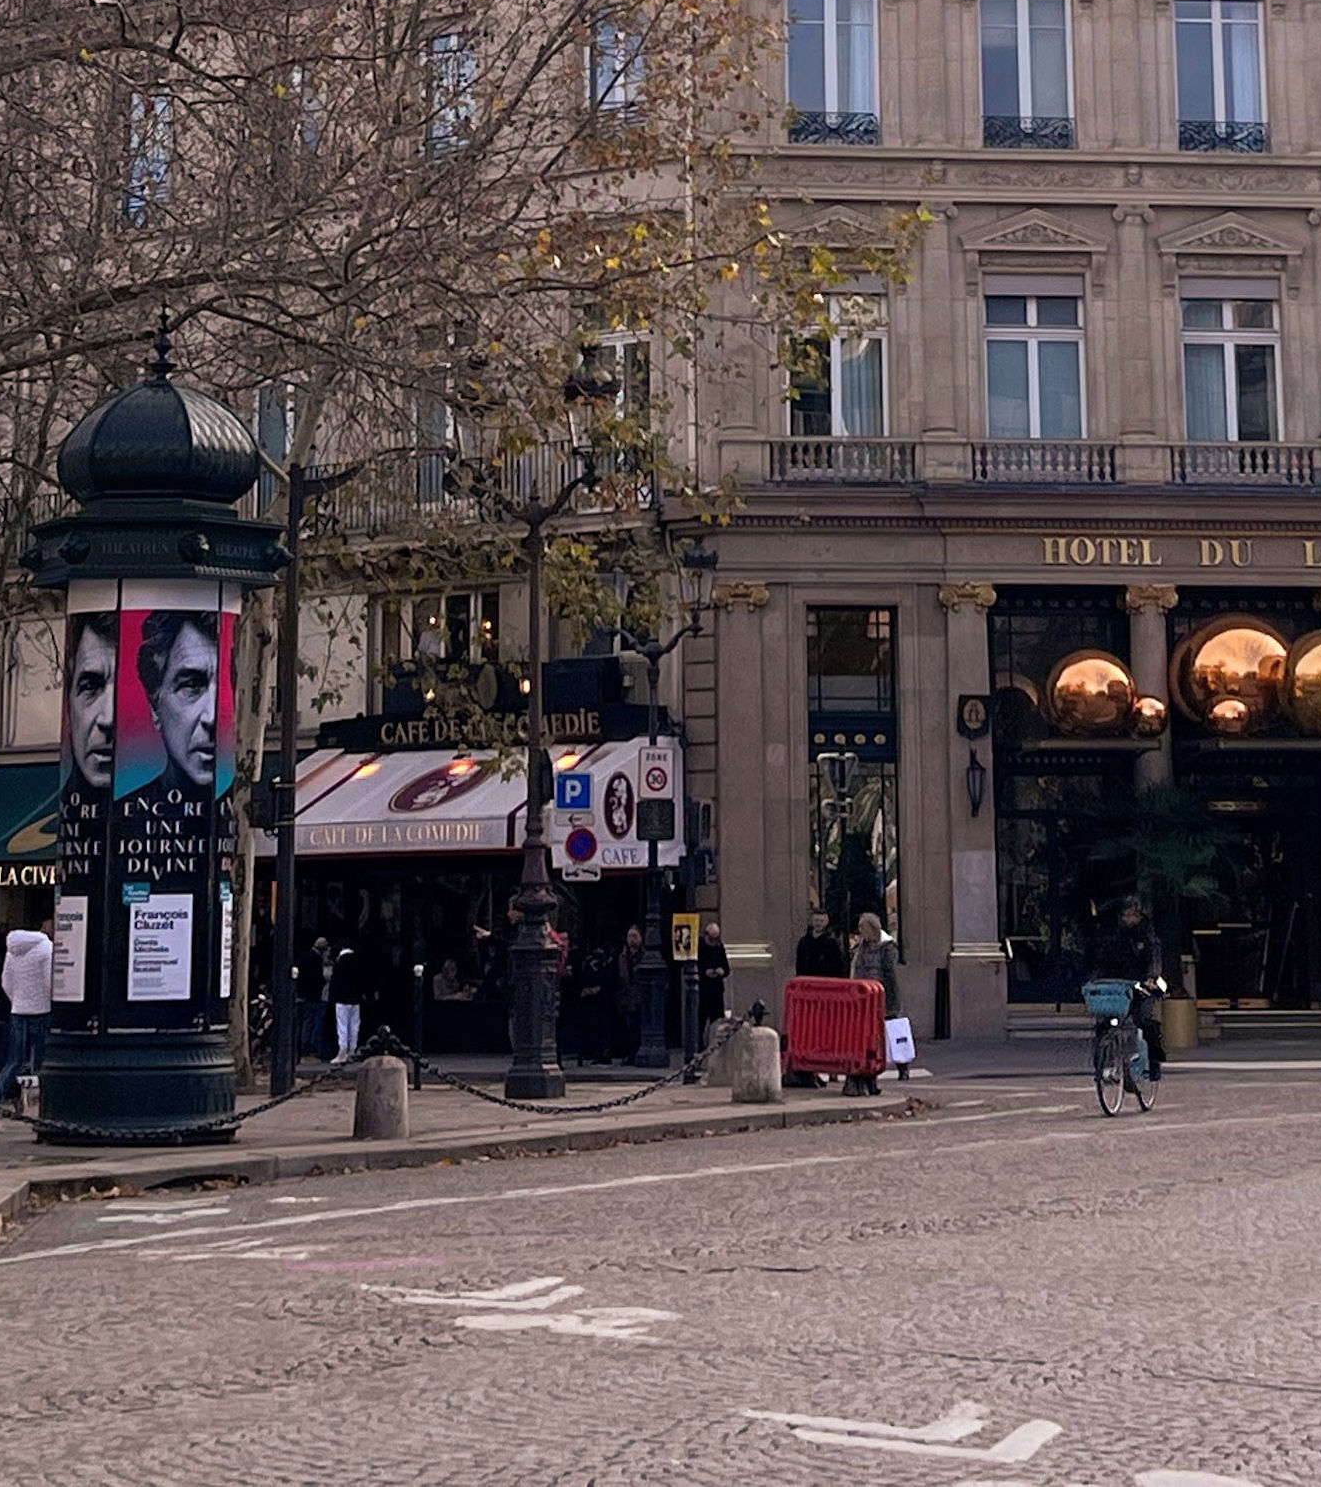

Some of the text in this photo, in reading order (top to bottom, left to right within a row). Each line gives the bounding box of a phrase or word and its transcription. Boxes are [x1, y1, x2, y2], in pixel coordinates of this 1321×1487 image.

[1041, 536, 1163, 566] HOTEL
[1199, 539, 1254, 568] DU
[646, 752, 668, 762] ZONE
[651, 773, 664, 786] 30
[565, 779, 583, 804] P
[123, 788, 205, 817] ENCORE
[145, 819, 185, 835] UNE
[117, 834, 206, 855] JOURNÉE
[601, 847, 641, 866] CAFE
[127, 856, 197, 882] DIVINE
[133, 908, 190, 922] François
